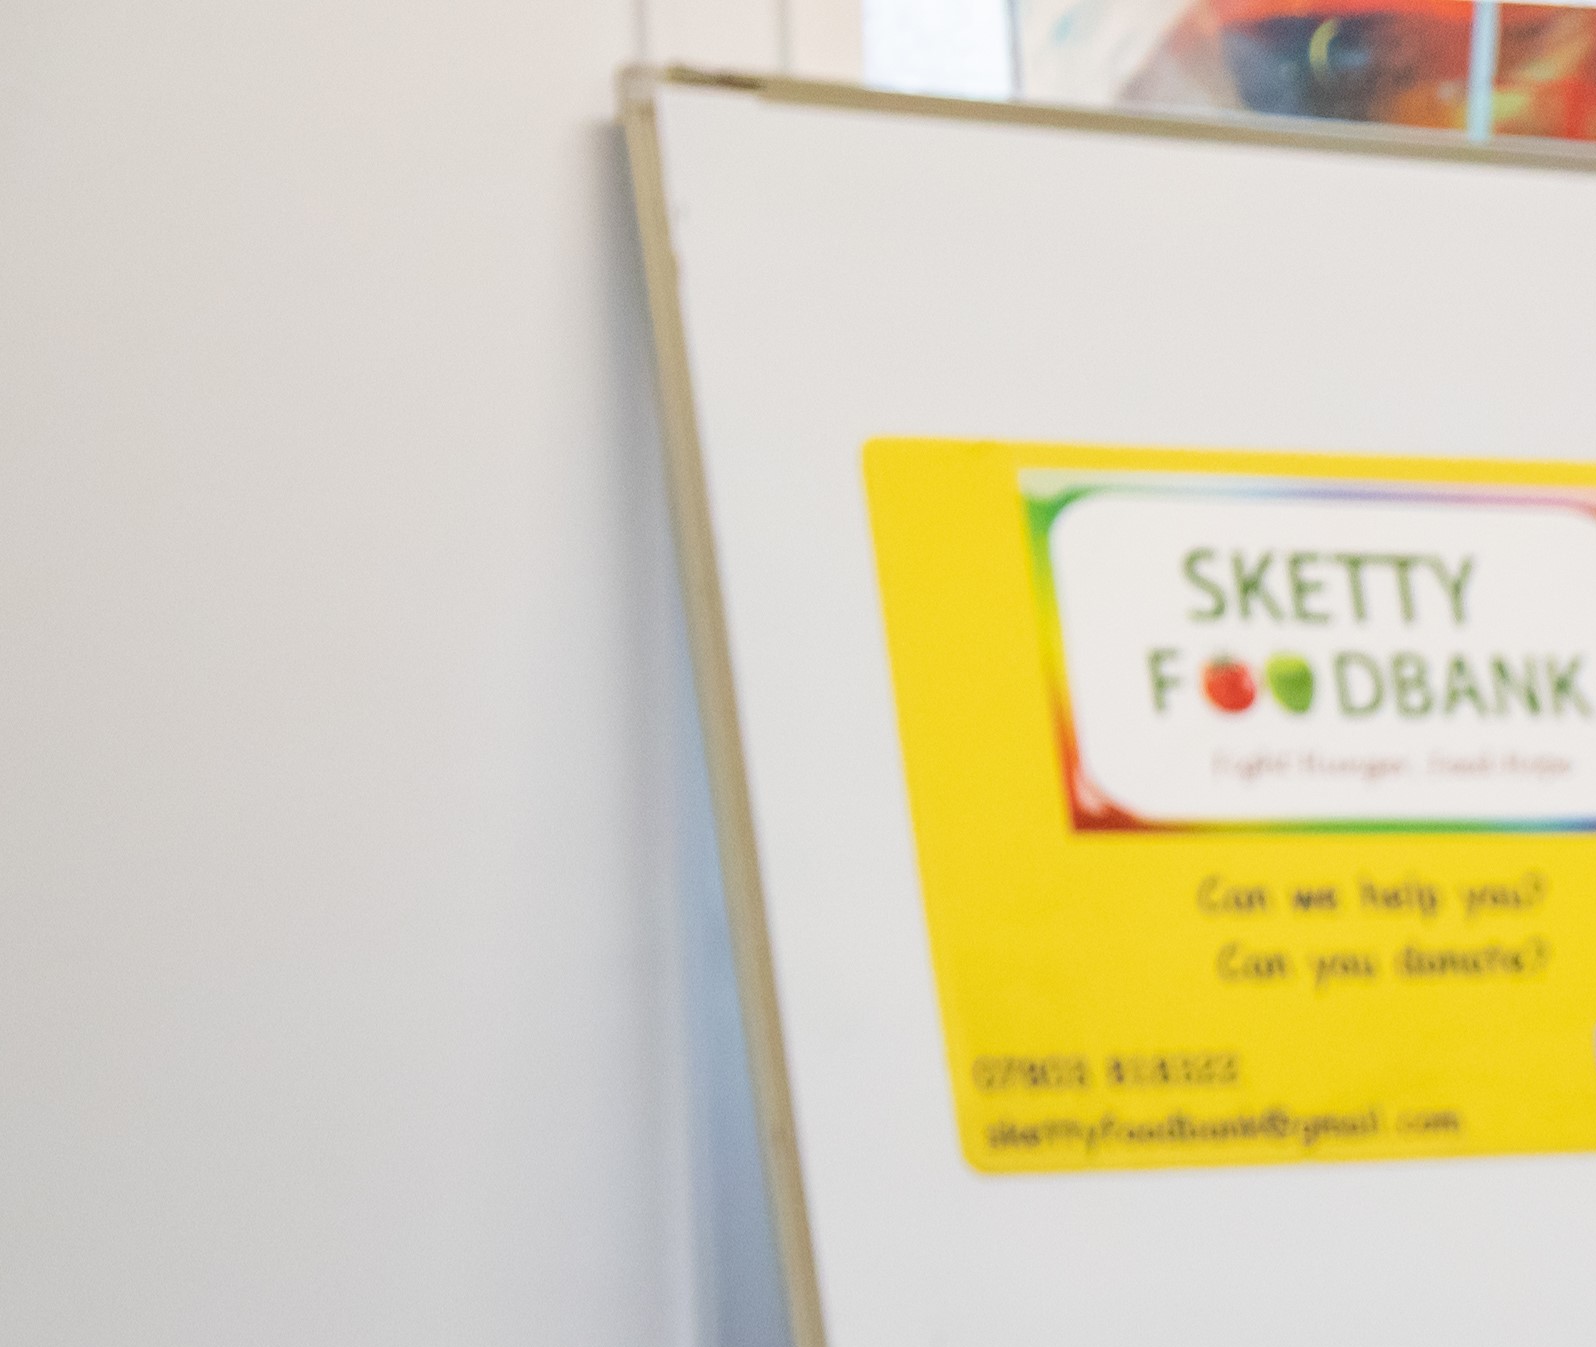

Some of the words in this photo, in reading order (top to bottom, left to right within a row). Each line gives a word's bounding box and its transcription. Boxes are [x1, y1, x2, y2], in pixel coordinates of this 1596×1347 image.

[1181, 546, 1477, 626] SKETTY
[1196, 874, 1269, 916] Can
[1290, 885, 1340, 914] we
[1358, 876, 1441, 922] help
[1459, 869, 1547, 922] you?
[1216, 941, 1290, 983] Can
[1310, 950, 1378, 994] you
[1395, 936, 1550, 982] donate?
